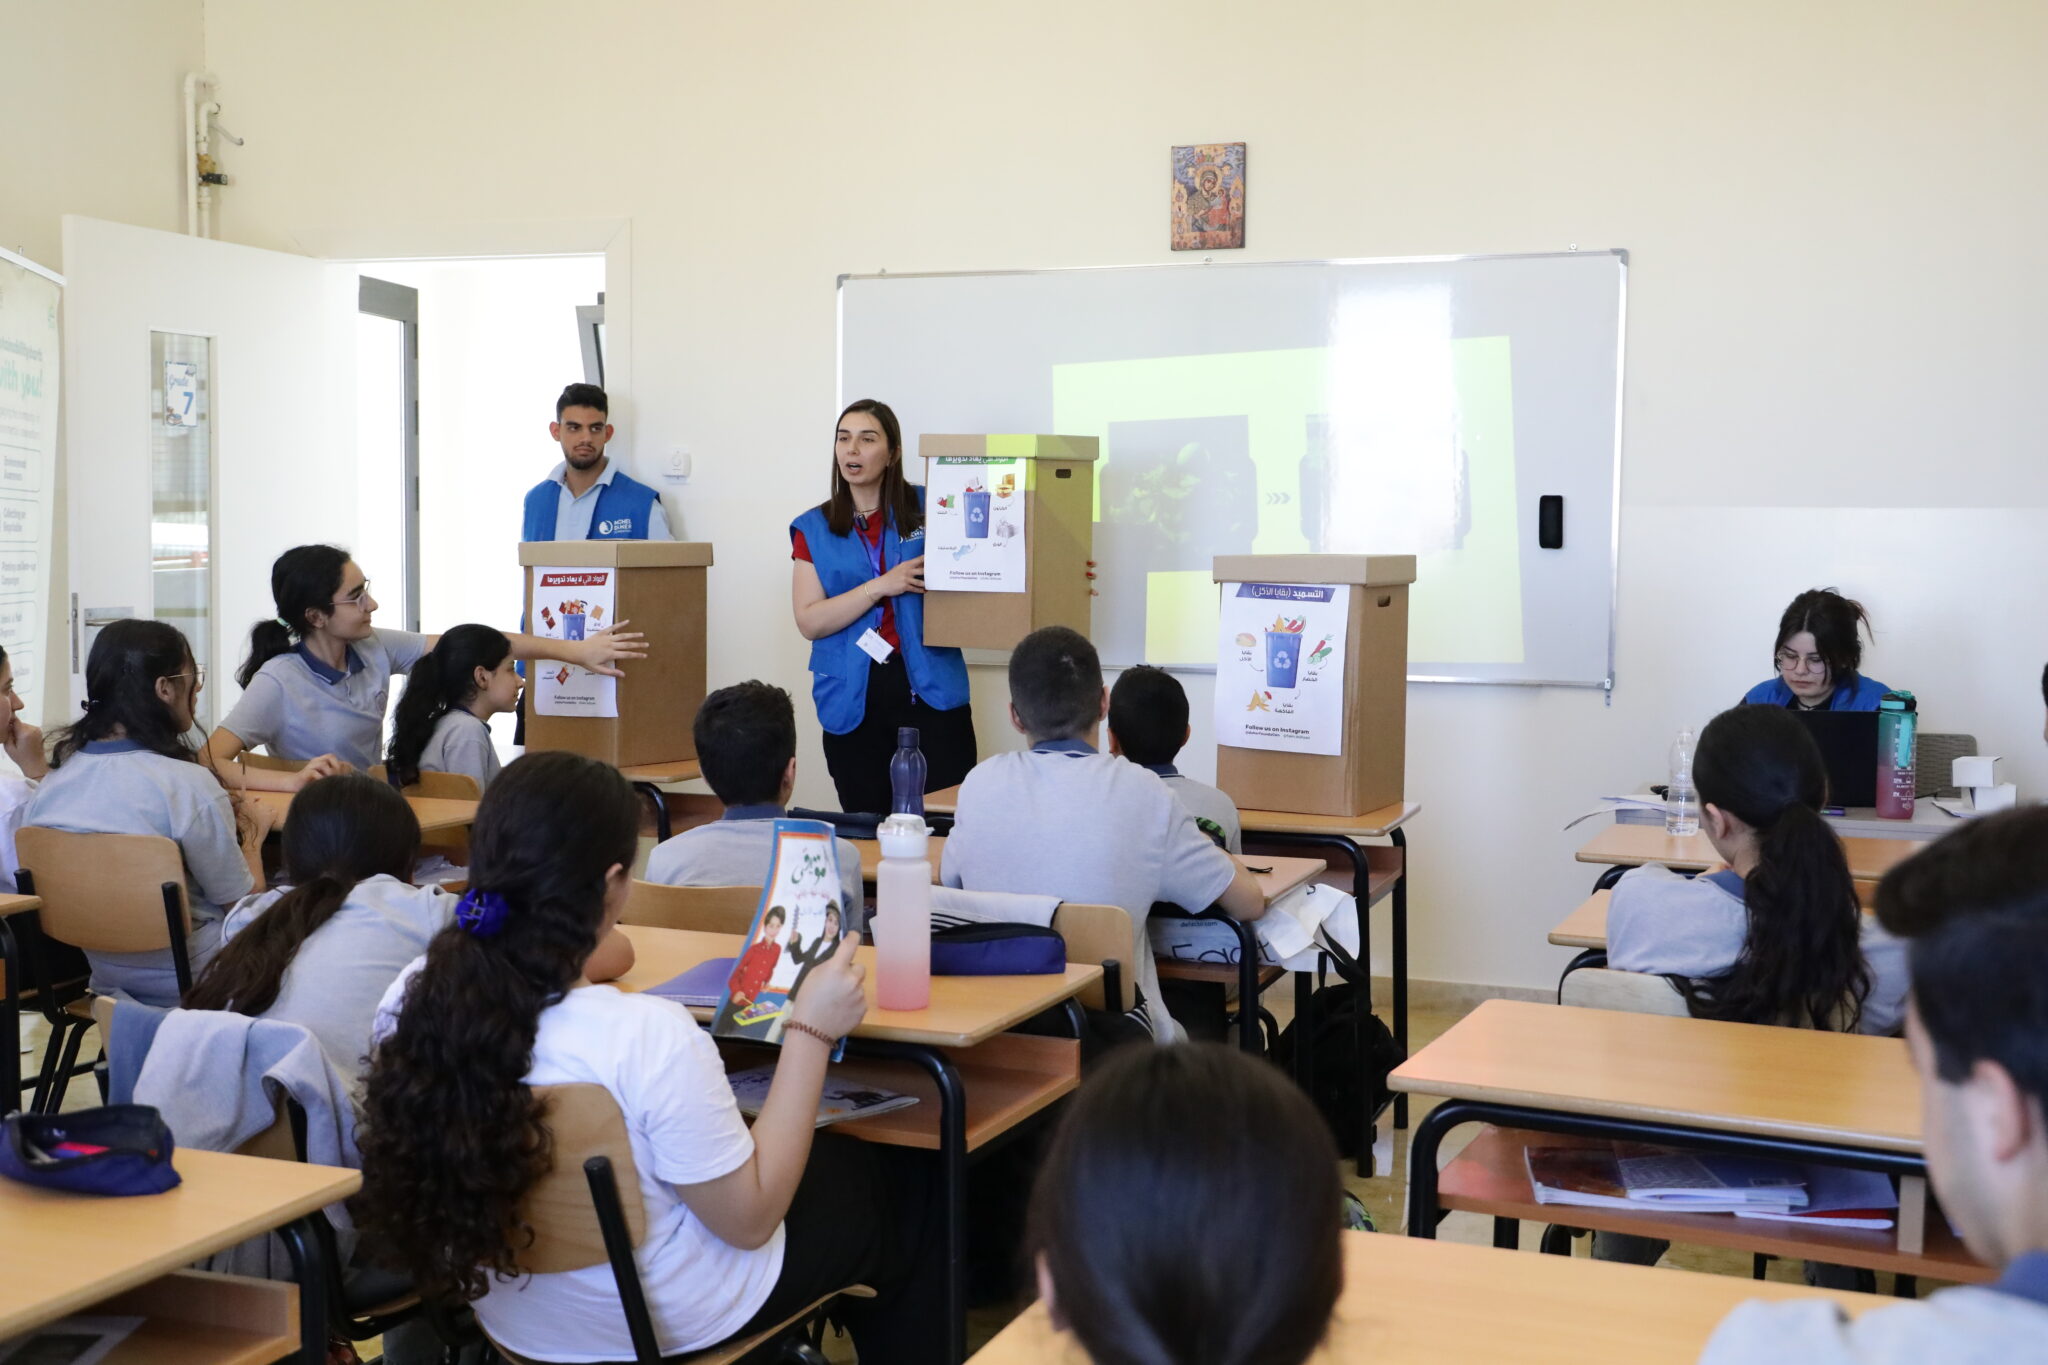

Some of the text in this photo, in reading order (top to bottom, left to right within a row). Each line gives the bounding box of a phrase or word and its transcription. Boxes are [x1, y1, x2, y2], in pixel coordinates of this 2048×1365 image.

[183, 391, 194, 415] 7
[1293, 589, 1324, 600] التسميد
[1280, 727, 1310, 735] Instagram
